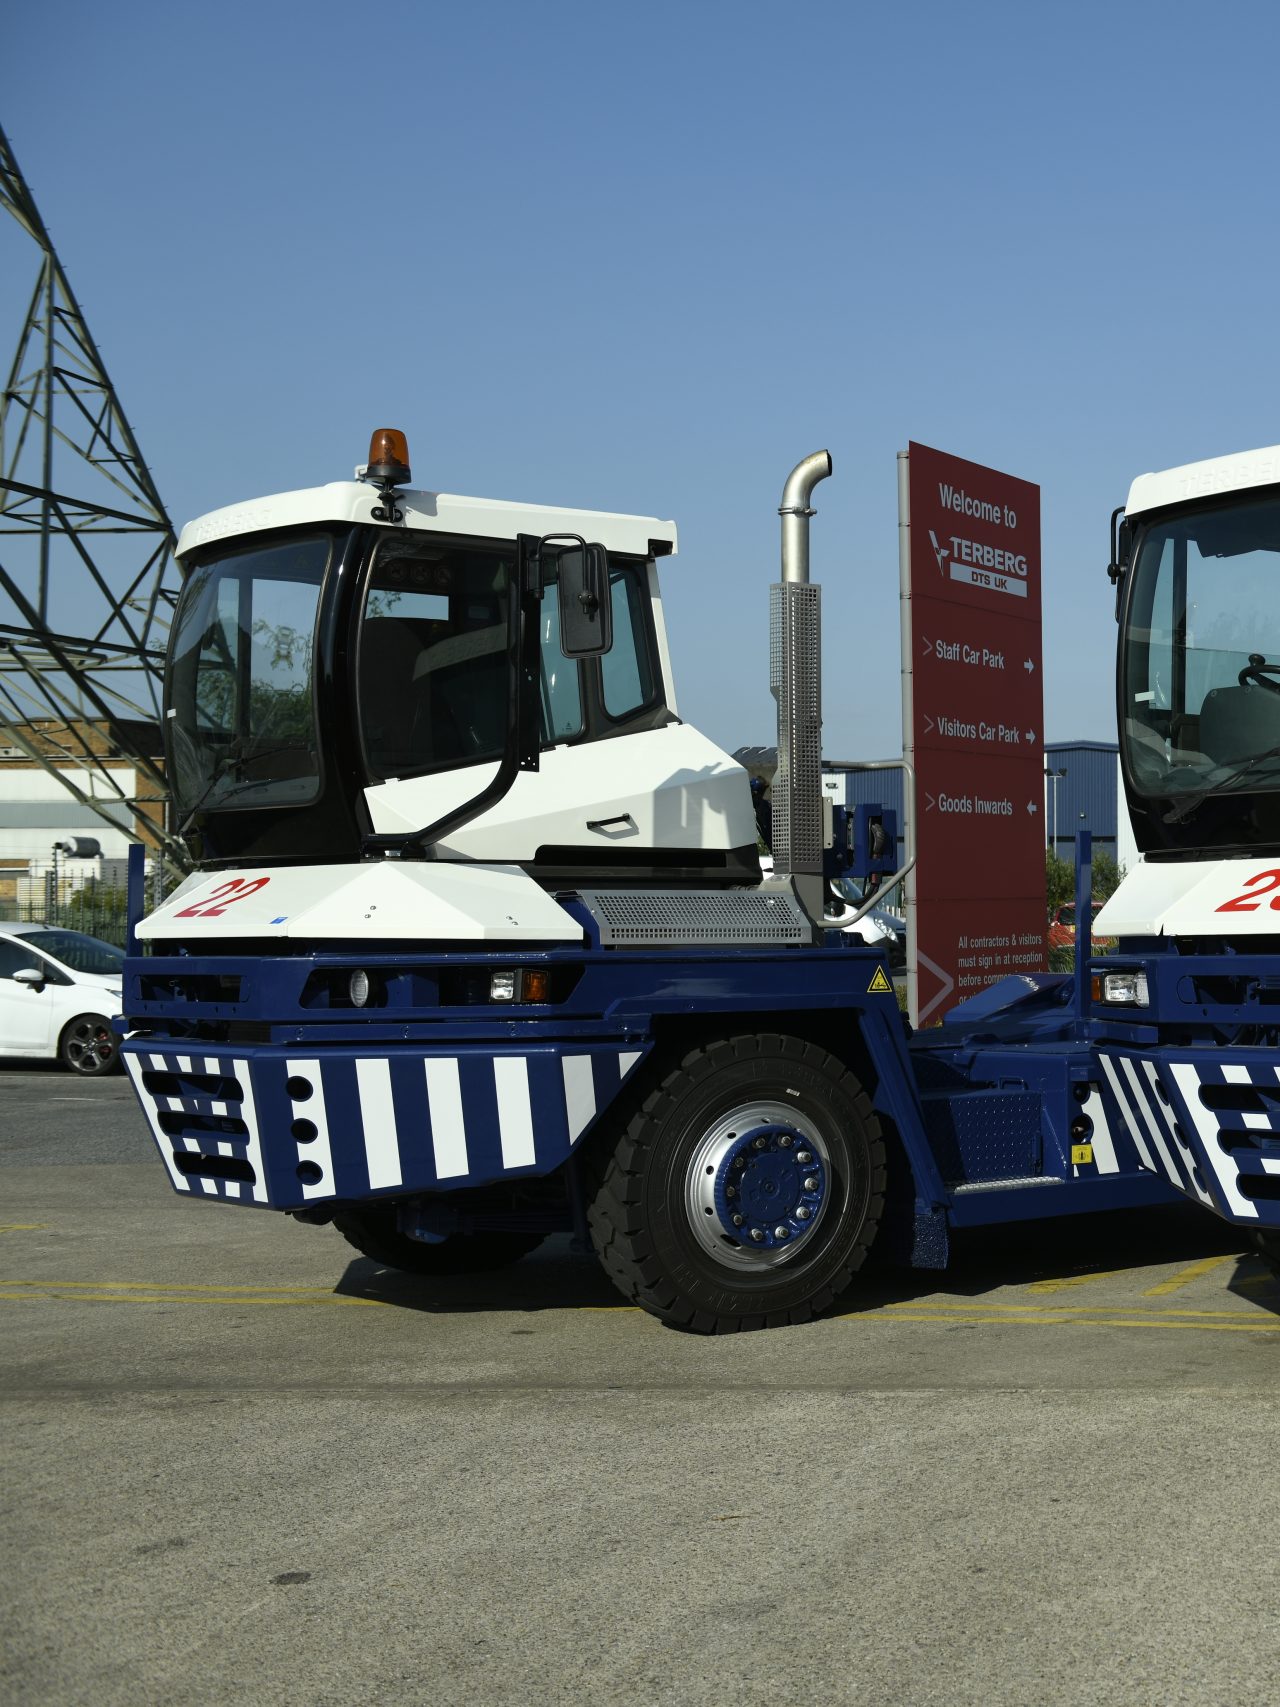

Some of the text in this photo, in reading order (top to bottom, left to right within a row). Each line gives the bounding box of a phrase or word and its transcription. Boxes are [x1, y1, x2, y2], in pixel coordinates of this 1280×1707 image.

[938, 482, 1017, 529] Welcome to
[949, 536, 1028, 576] TERBERG
[971, 570, 1008, 590] DTS UK
[935, 639, 1005, 669] Staff Car Park
[937, 716, 1020, 744] Visitors Car Park
[938, 793, 1013, 816] Goods Inwards
[173, 877, 271, 918] 22
[958, 933, 1042, 949] All contractors & visitors
[958, 951, 1043, 969] must sign in at reception
[958, 973, 981, 987] before
